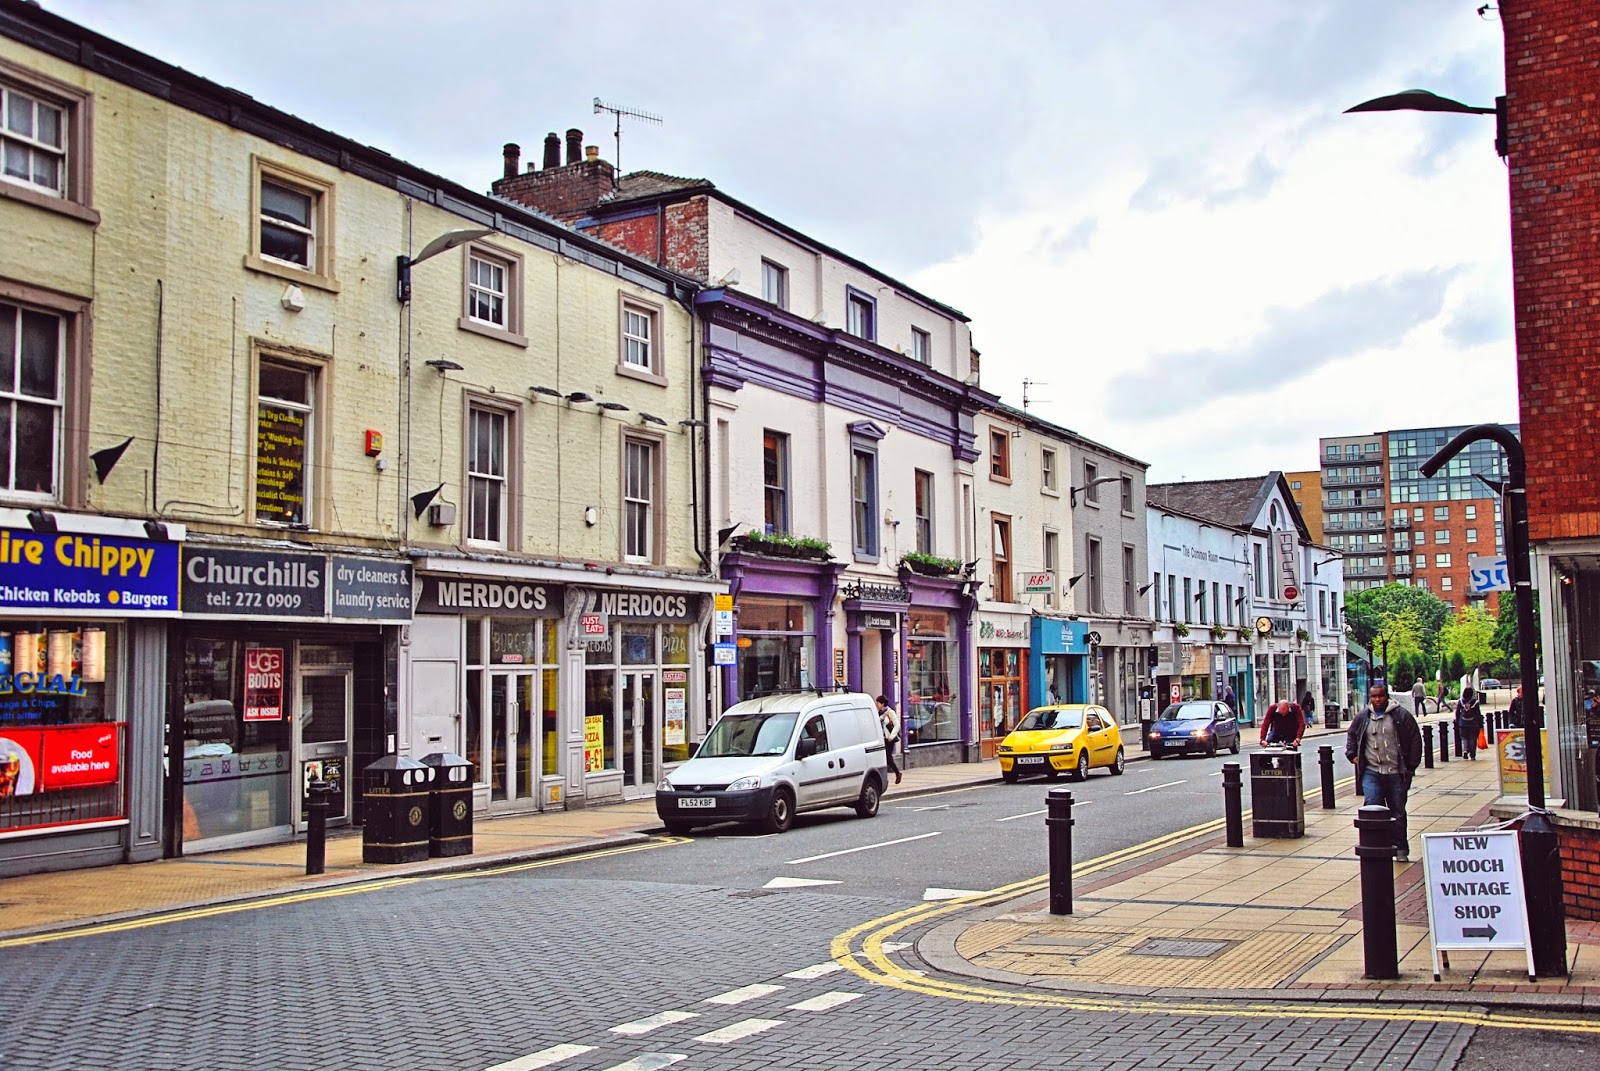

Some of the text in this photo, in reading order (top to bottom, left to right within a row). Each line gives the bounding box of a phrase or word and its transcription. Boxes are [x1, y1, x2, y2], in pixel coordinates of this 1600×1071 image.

[0, 530, 155, 578] ire Chippy
[1190, 546, 1208, 560] Common
[186, 556, 320, 588] Churchills
[337, 564, 409, 586] dry cleaners &
[54, 588, 100, 604] Kebabs
[122, 591, 168, 608] Burgers
[206, 591, 302, 608] tel: 272 0909
[335, 590, 410, 611] laundry service
[438, 581, 547, 610] MERDOCS
[602, 593, 687, 618] MERDOCS
[582, 616, 600, 625] JUST
[586, 624, 600, 633] EAT
[662, 636, 686, 654] PIZZA
[248, 652, 280, 672] UGG
[248, 672, 280, 689] BOOTS
[1172, 685, 1180, 698] 8
[246, 707, 280, 717] ASK INSIDE
[71, 749, 93, 760] Food
[51, 760, 110, 774] available here
[1453, 836, 1489, 851] NEW
[1442, 858, 1504, 874] MOOCH
[1440, 882, 1512, 896] VINTAGE
[1454, 905, 1502, 920] SHOP
